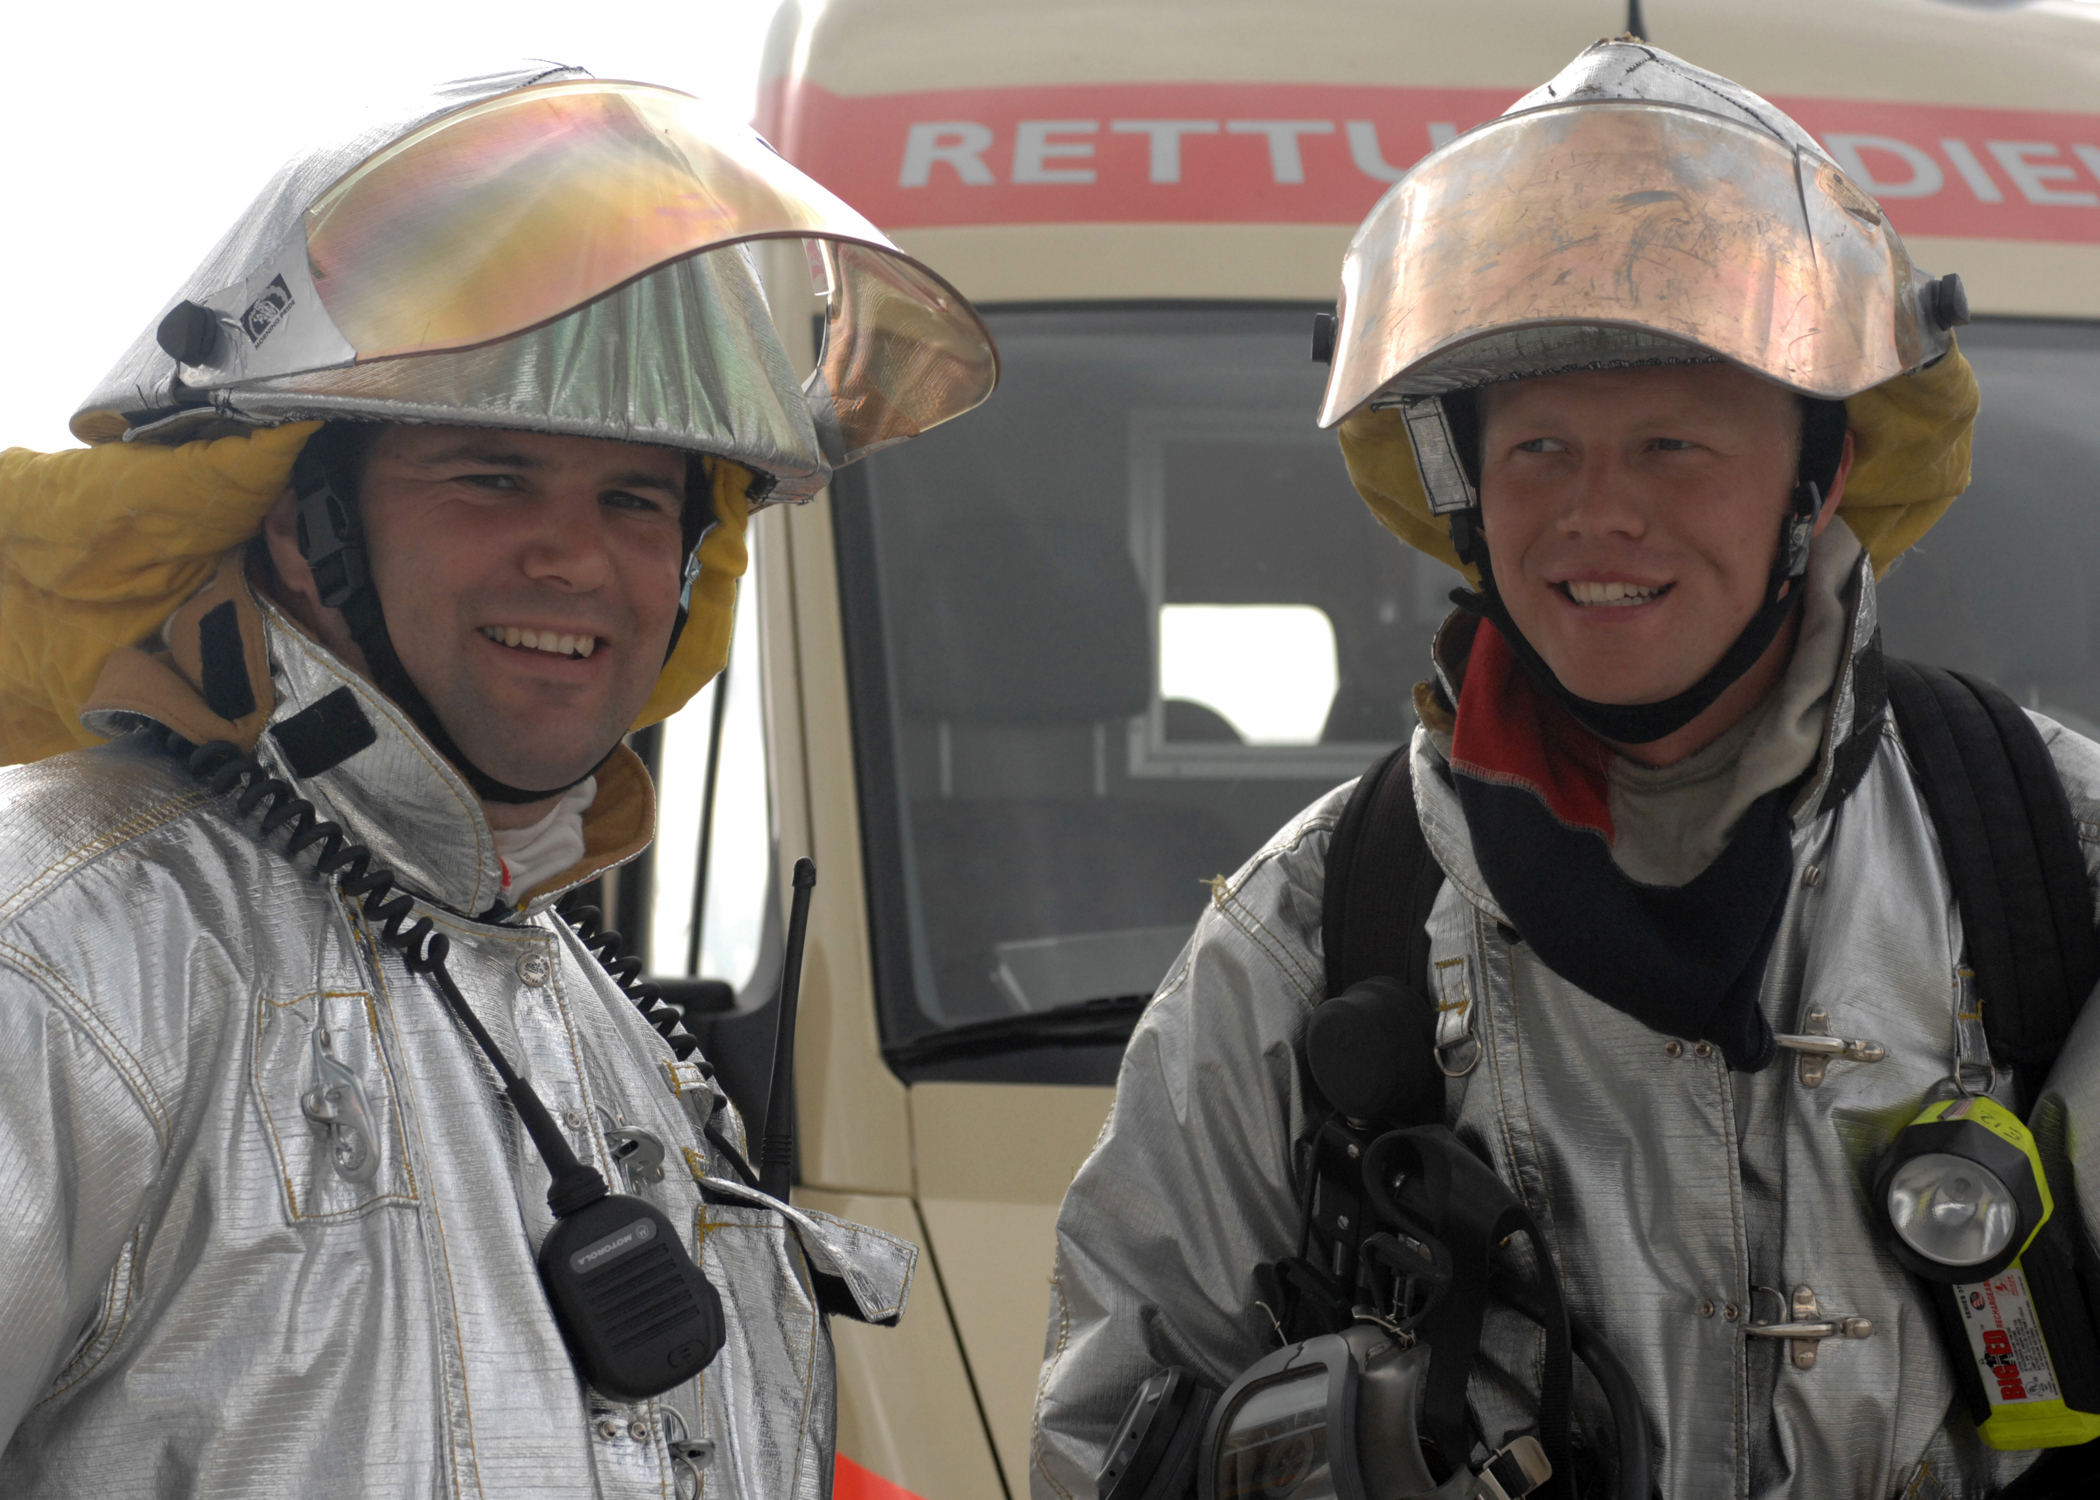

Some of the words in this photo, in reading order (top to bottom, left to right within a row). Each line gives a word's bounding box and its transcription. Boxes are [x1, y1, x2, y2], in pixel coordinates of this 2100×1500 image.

[254, 317, 280, 350] MORNING
[279, 298, 296, 319] PRIDE
[577, 1233, 632, 1265] MOTOROLA
[1960, 1295, 1972, 1319] SERIES
[1982, 1329, 2012, 1355] ED
[1992, 1363, 2027, 1400] BIG
